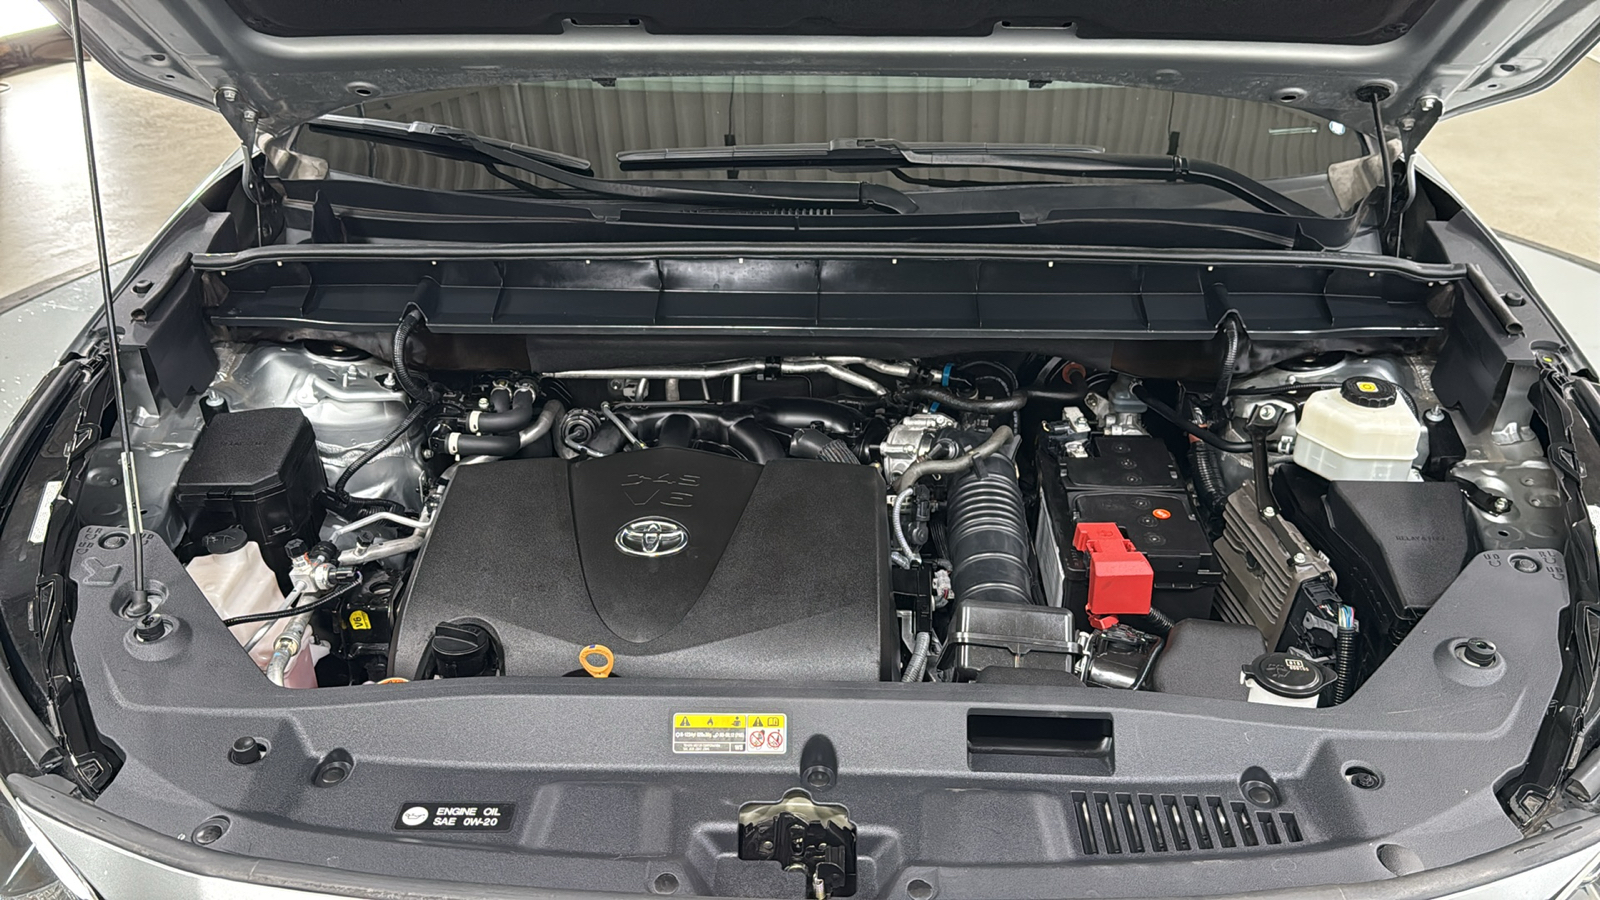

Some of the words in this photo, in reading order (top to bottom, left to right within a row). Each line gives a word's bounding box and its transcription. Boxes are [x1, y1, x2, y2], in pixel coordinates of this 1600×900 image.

[436, 807, 478, 816] ENGINE
[483, 807, 501, 816] OIL
[432, 817, 458, 826] SAE
[463, 817, 498, 827] 0W-20
